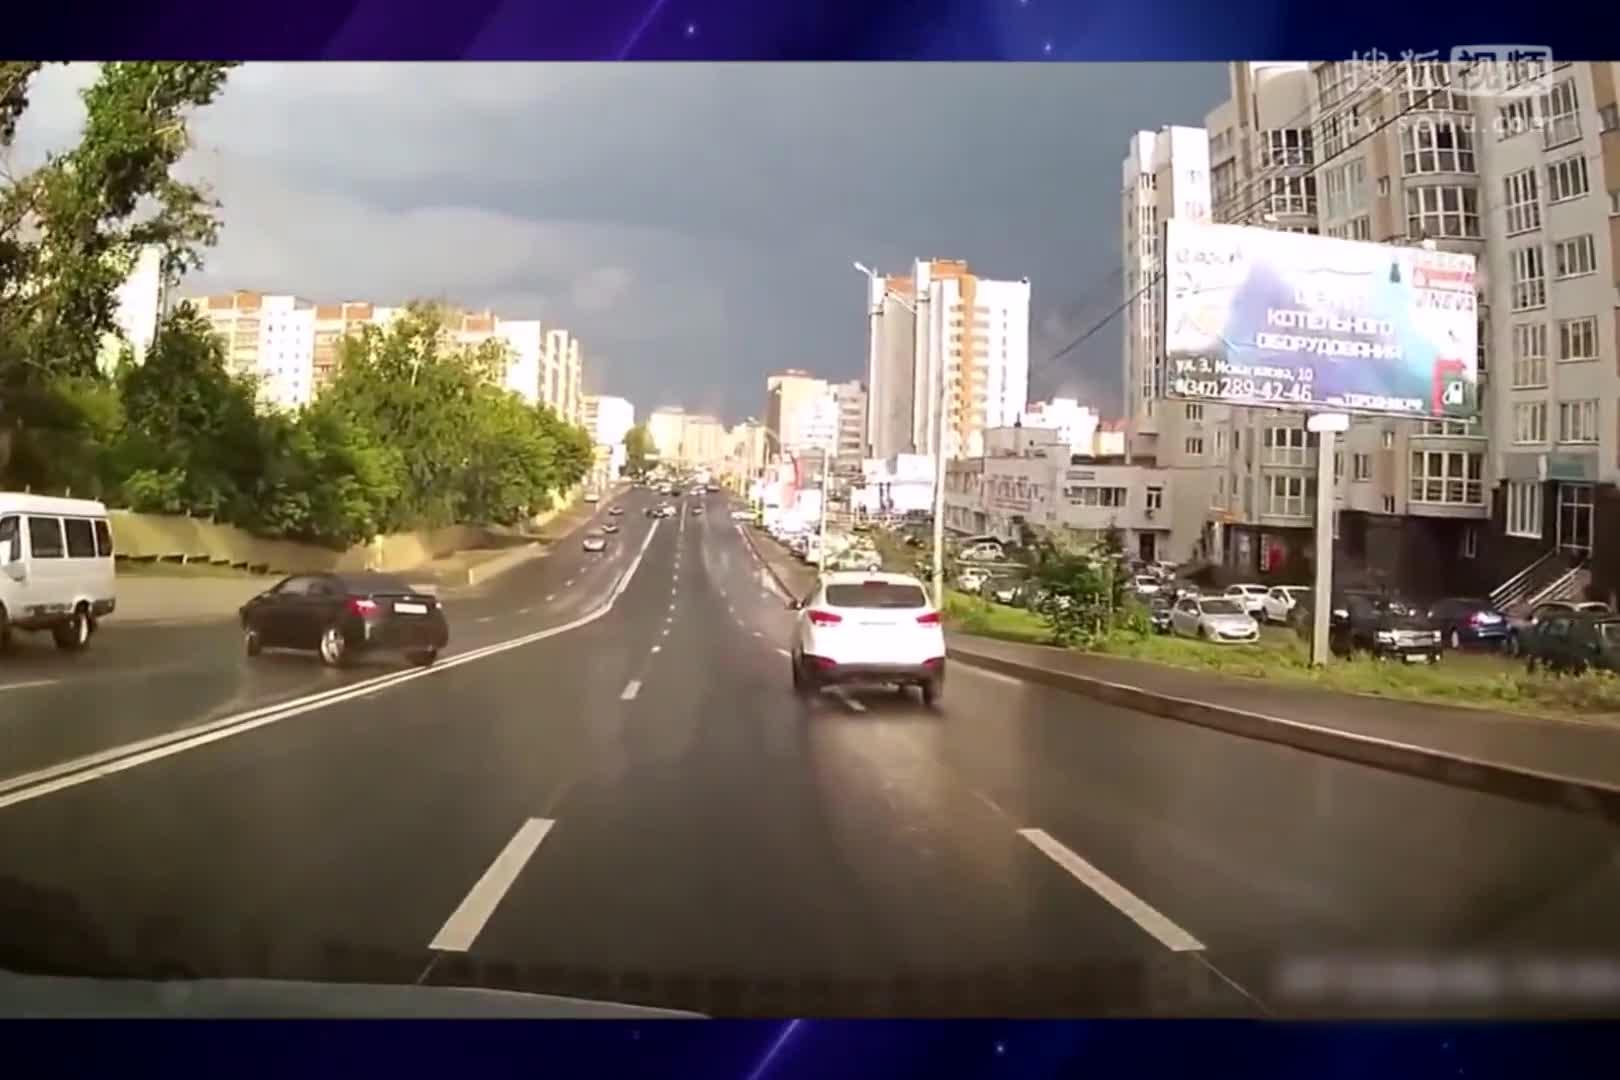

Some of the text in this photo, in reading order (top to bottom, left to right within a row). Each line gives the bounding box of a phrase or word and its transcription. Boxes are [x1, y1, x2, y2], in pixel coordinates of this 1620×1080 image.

[1267, 308, 1393, 335] КОТЕЛЬНОГО
[1257, 332, 1402, 359] ОБОРУДОВАНИЯ
[1298, 367, 1313, 381] 10
[1220, 378, 1313, 402] 289-42-46
